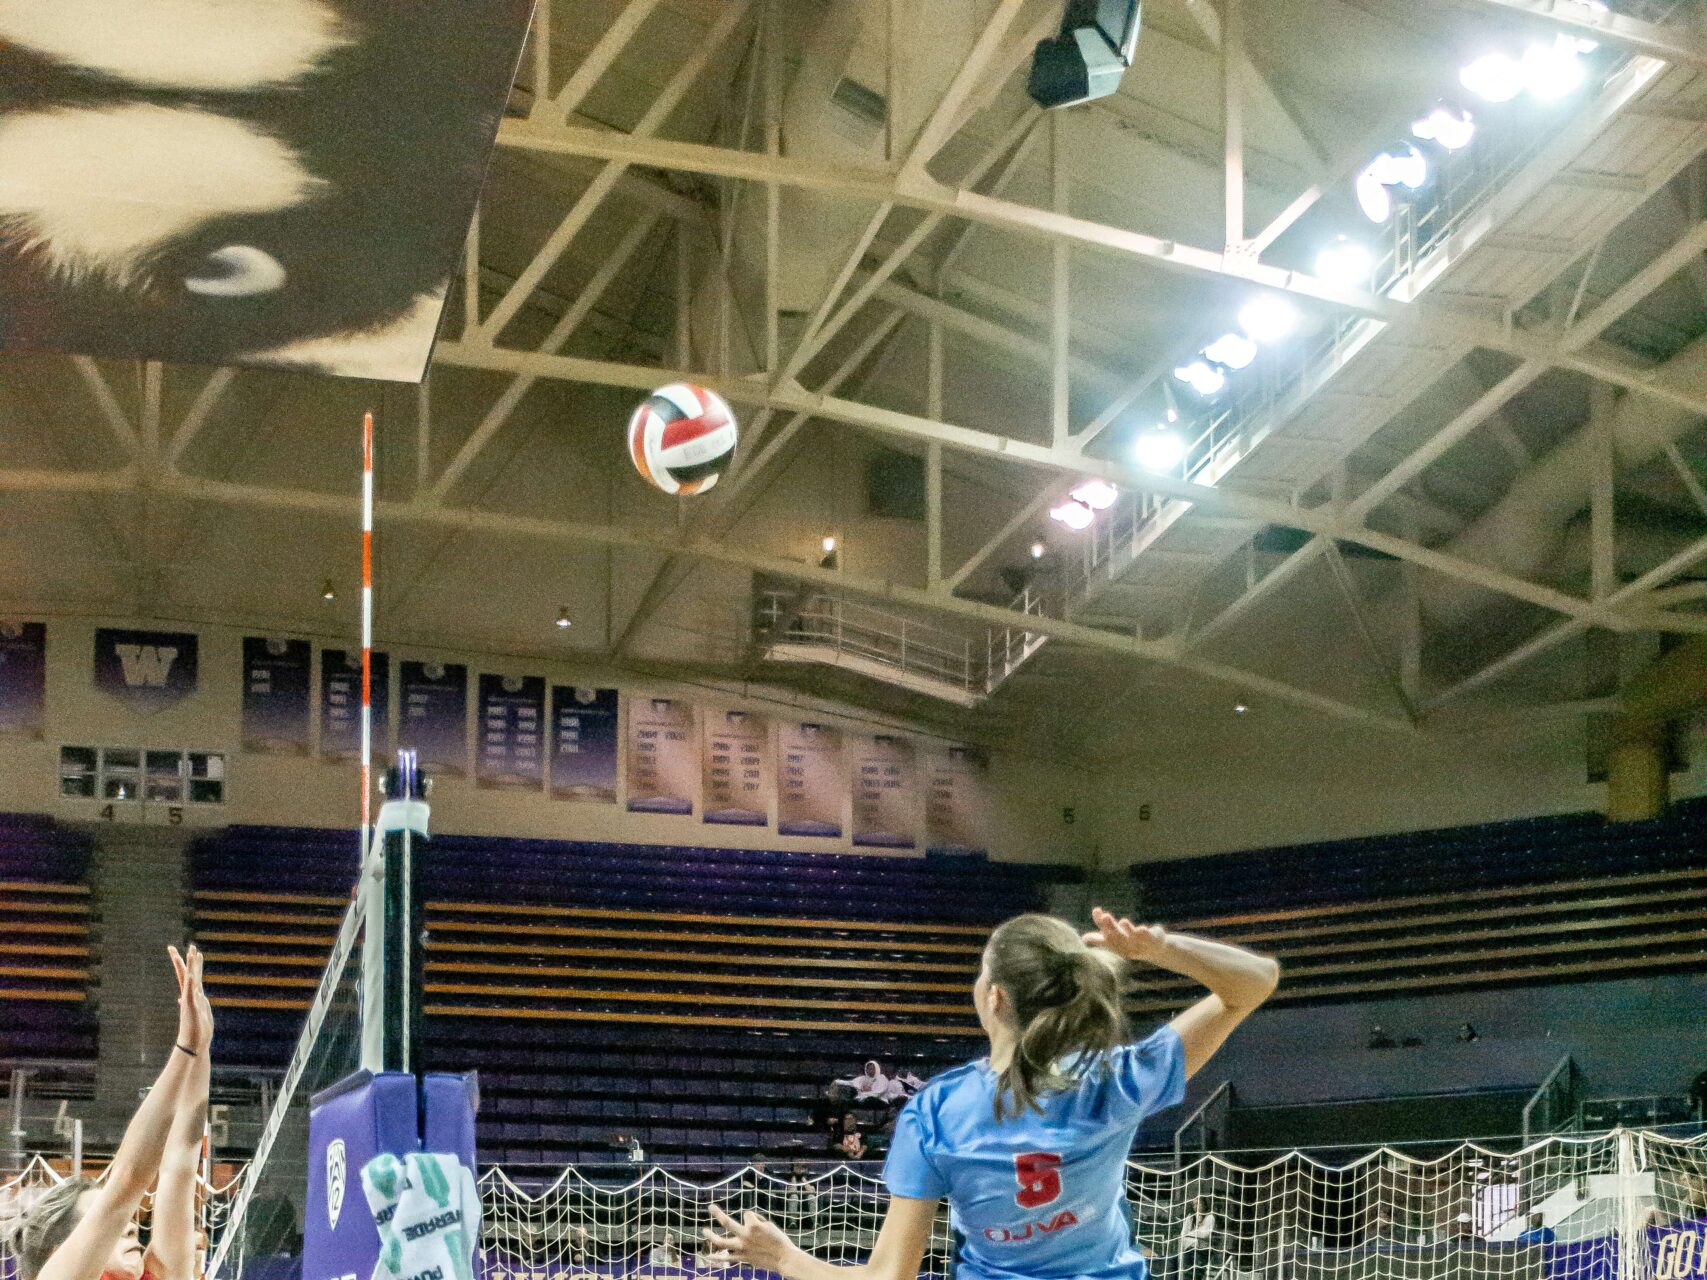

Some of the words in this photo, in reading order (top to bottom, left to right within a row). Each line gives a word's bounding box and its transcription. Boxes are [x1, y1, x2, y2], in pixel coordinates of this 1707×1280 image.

[115, 643, 178, 687] W
[101, 804, 115, 820] 4
[169, 807, 182, 824] 5
[1013, 1152, 1063, 1209] 5
[1656, 1230, 1697, 1280] GO
